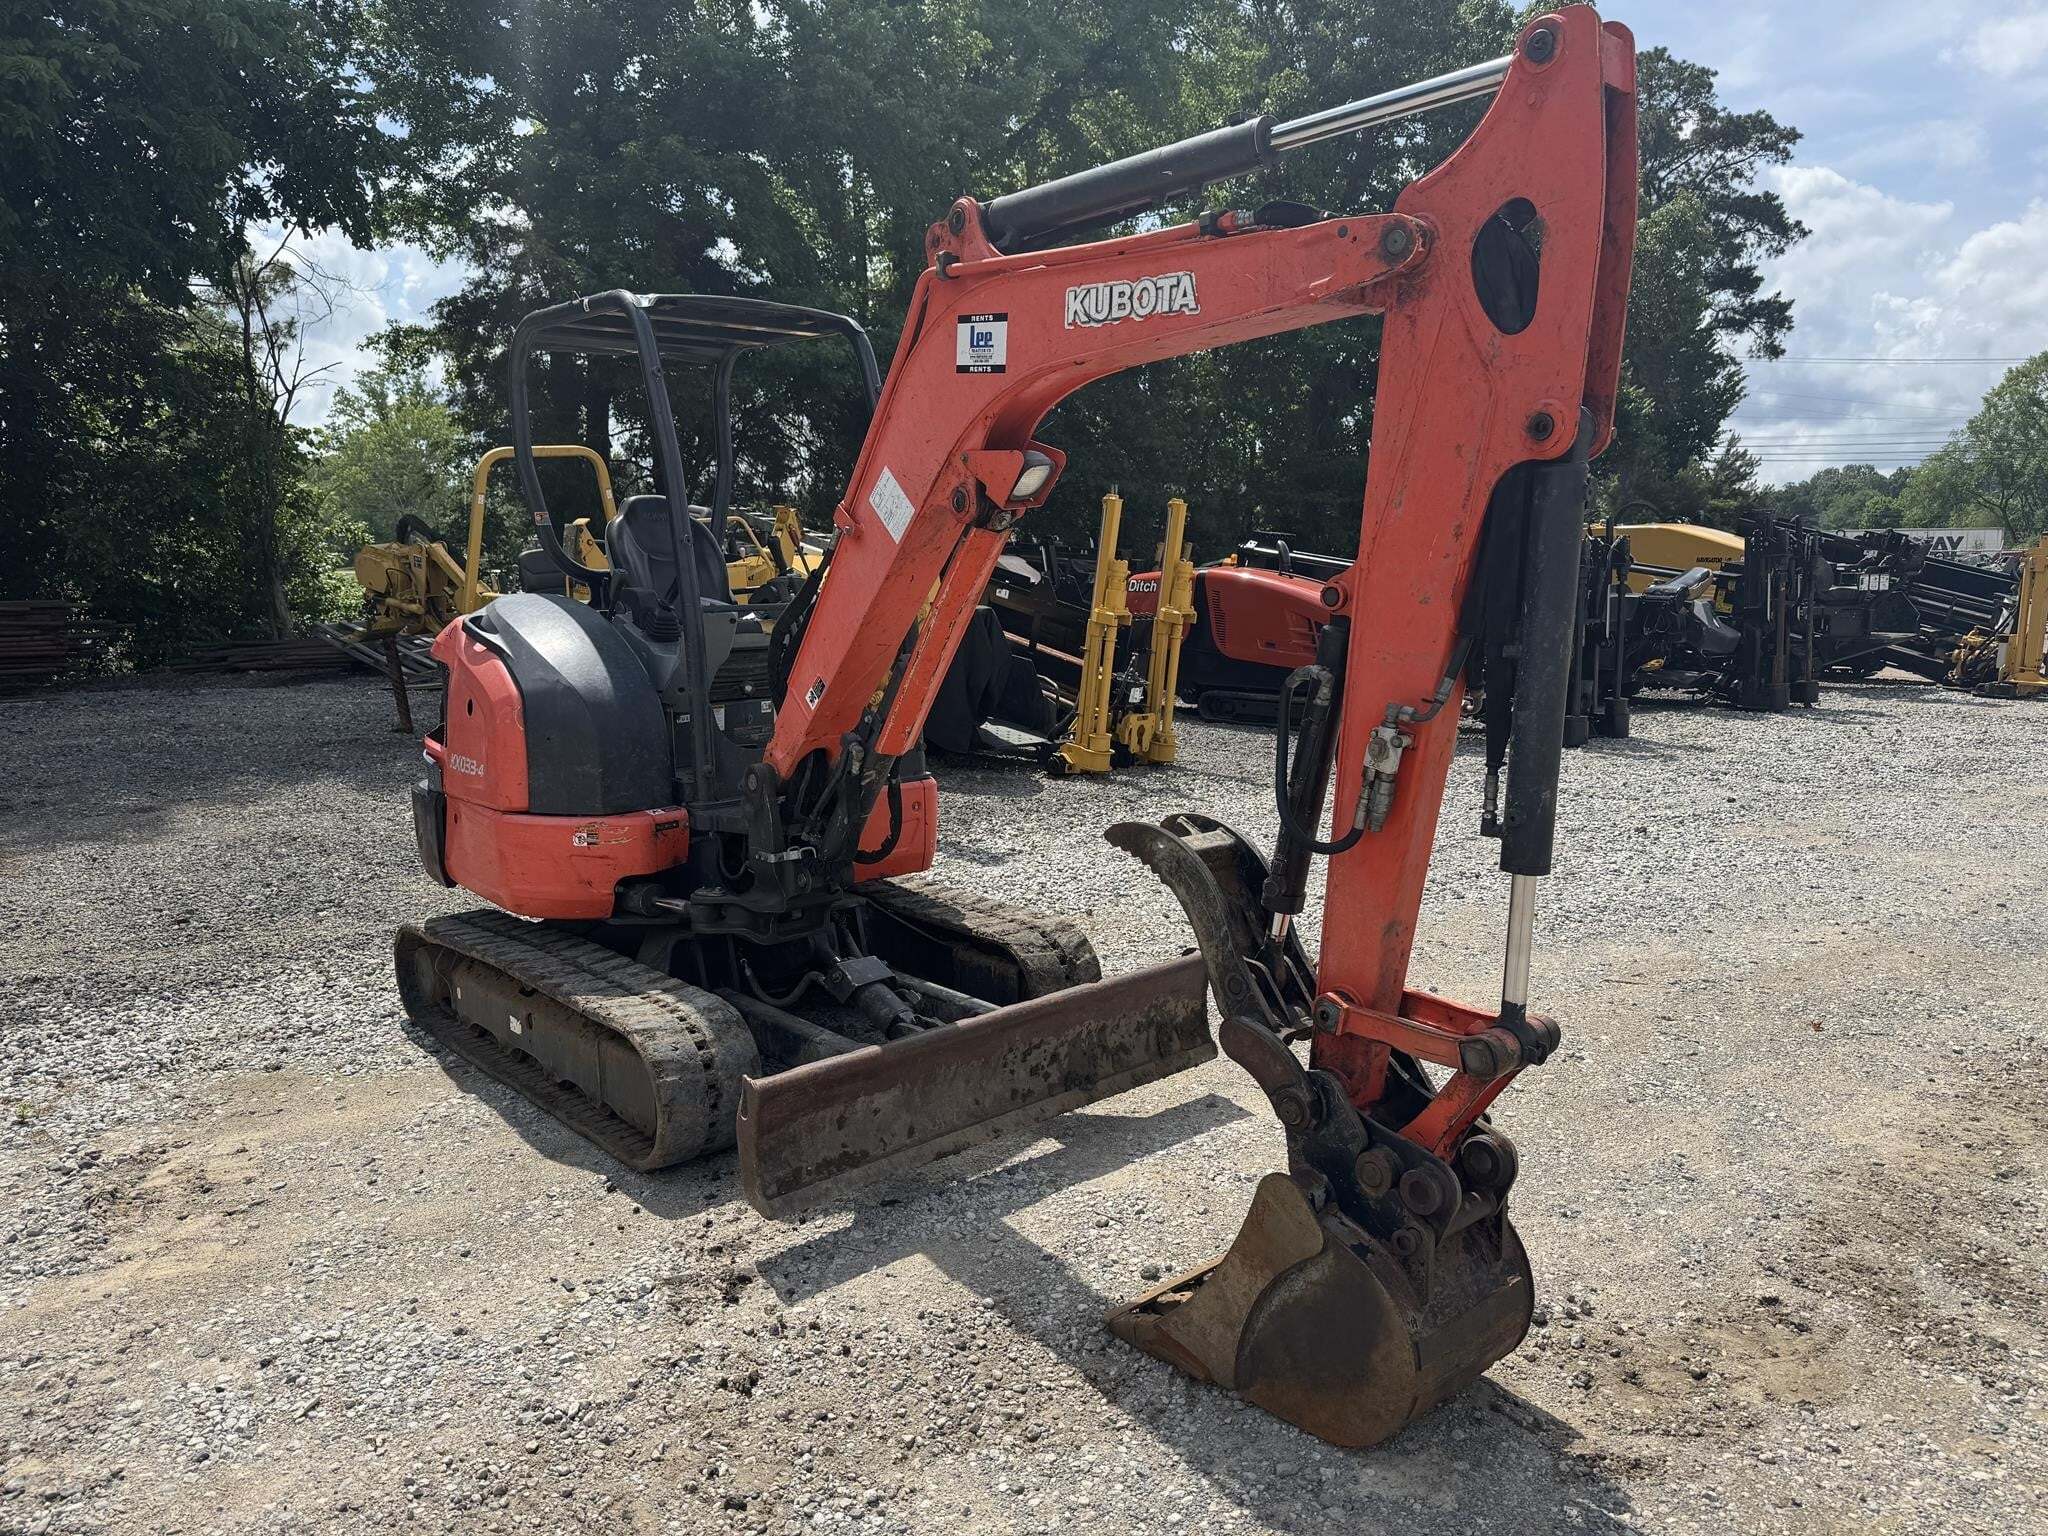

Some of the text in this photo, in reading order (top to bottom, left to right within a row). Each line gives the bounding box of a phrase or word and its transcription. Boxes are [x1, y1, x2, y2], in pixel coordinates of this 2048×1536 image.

[1067, 273, 1199, 327] KUBOTA
[970, 325, 994, 348] Lee
[1928, 536, 1965, 550] AY
[1128, 579, 1157, 592] Ditch
